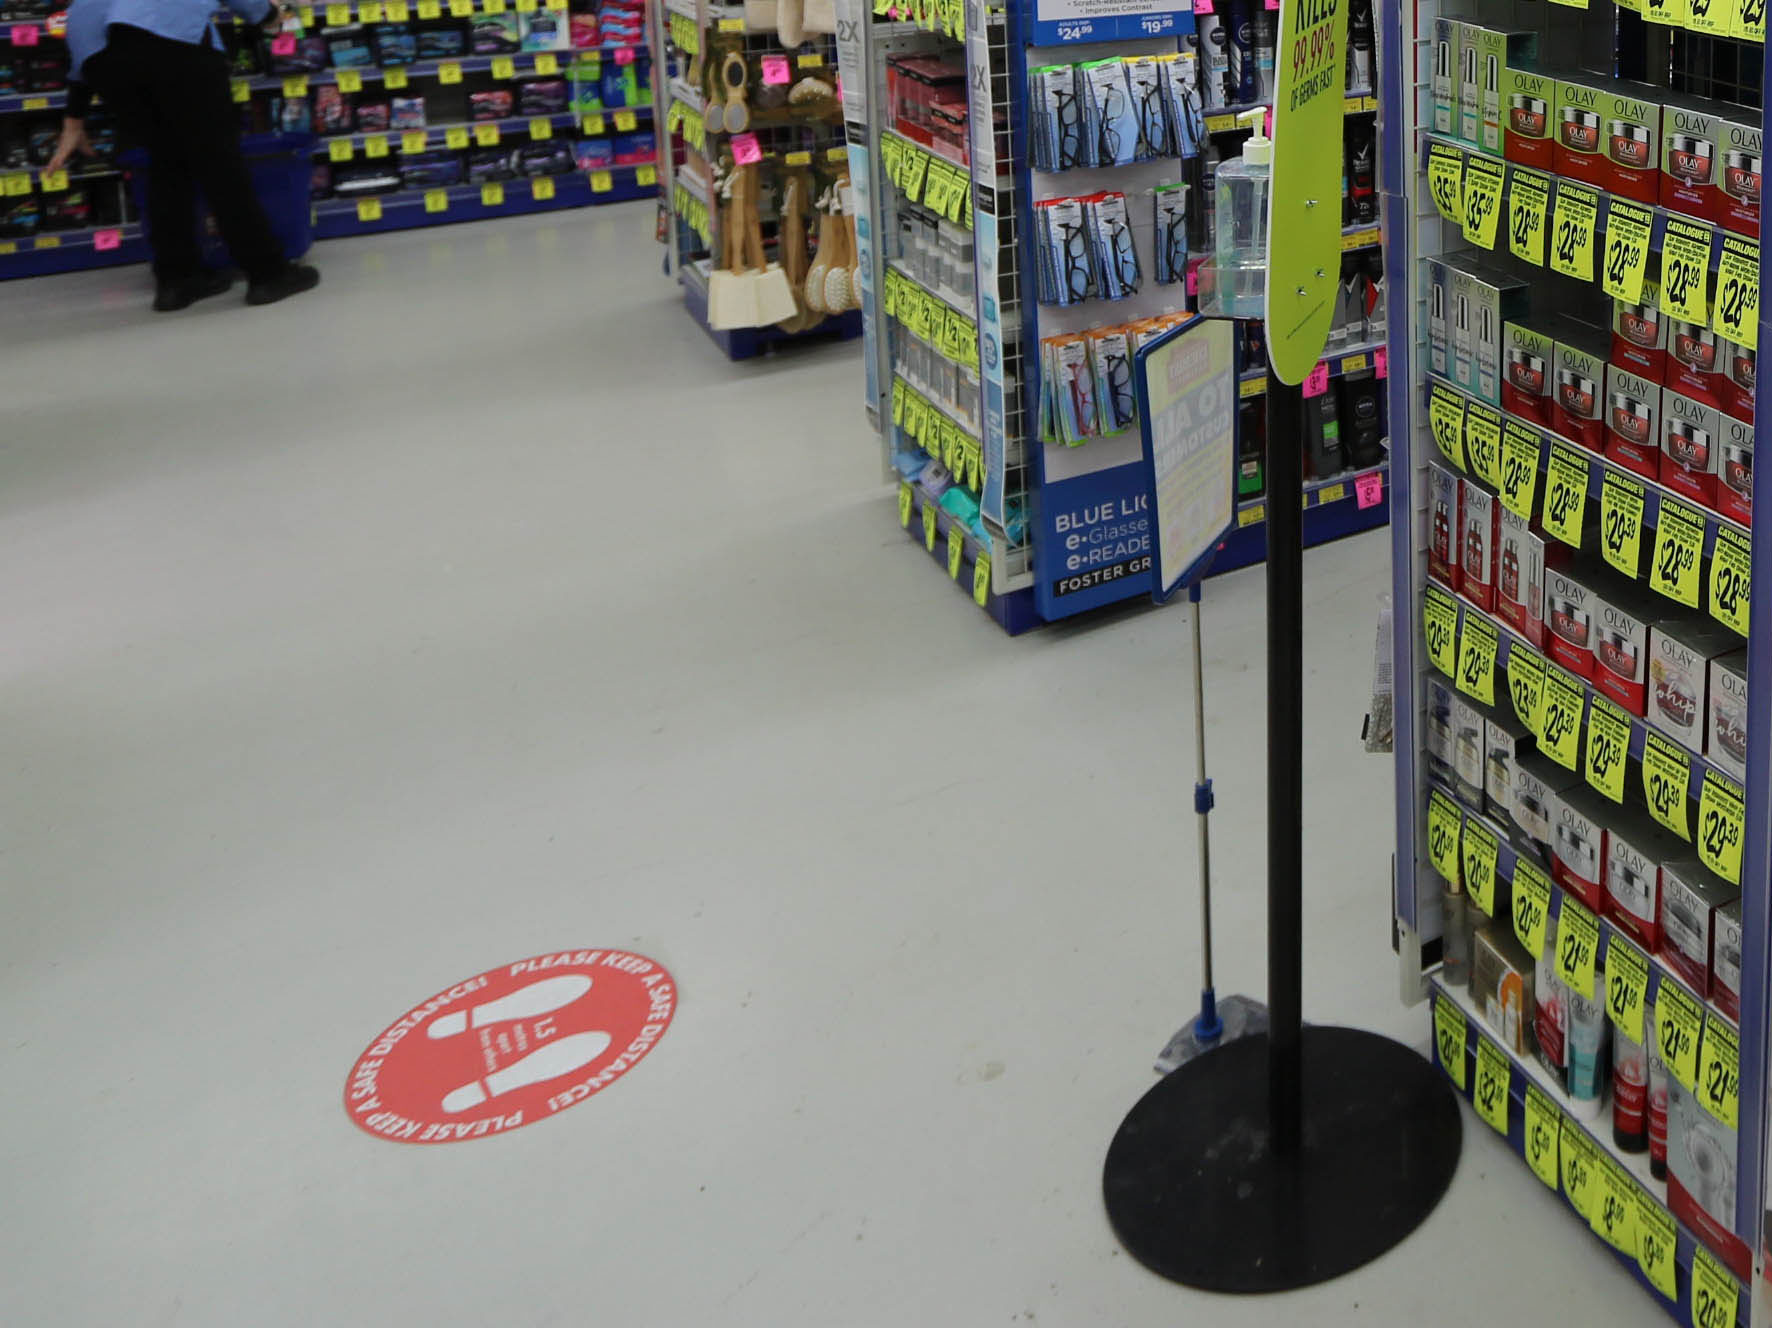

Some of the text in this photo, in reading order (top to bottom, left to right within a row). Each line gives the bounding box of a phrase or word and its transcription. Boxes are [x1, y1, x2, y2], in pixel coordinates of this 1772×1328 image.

[1120, 3, 1152, 13] Contrast
[1292, 22, 1335, 82] 99.99%
[1290, 63, 1335, 112] OF GERMS FAST
[1613, 99, 1648, 120] OLAY
[1554, 577, 1587, 604] OLAY
[510, 951, 606, 977] PLEASE
[601, 951, 653, 975] KEEP
[641, 973, 663, 989] A
[649, 984, 672, 1023] SAFE
[547, 1020, 660, 1112] DISTANCE!
